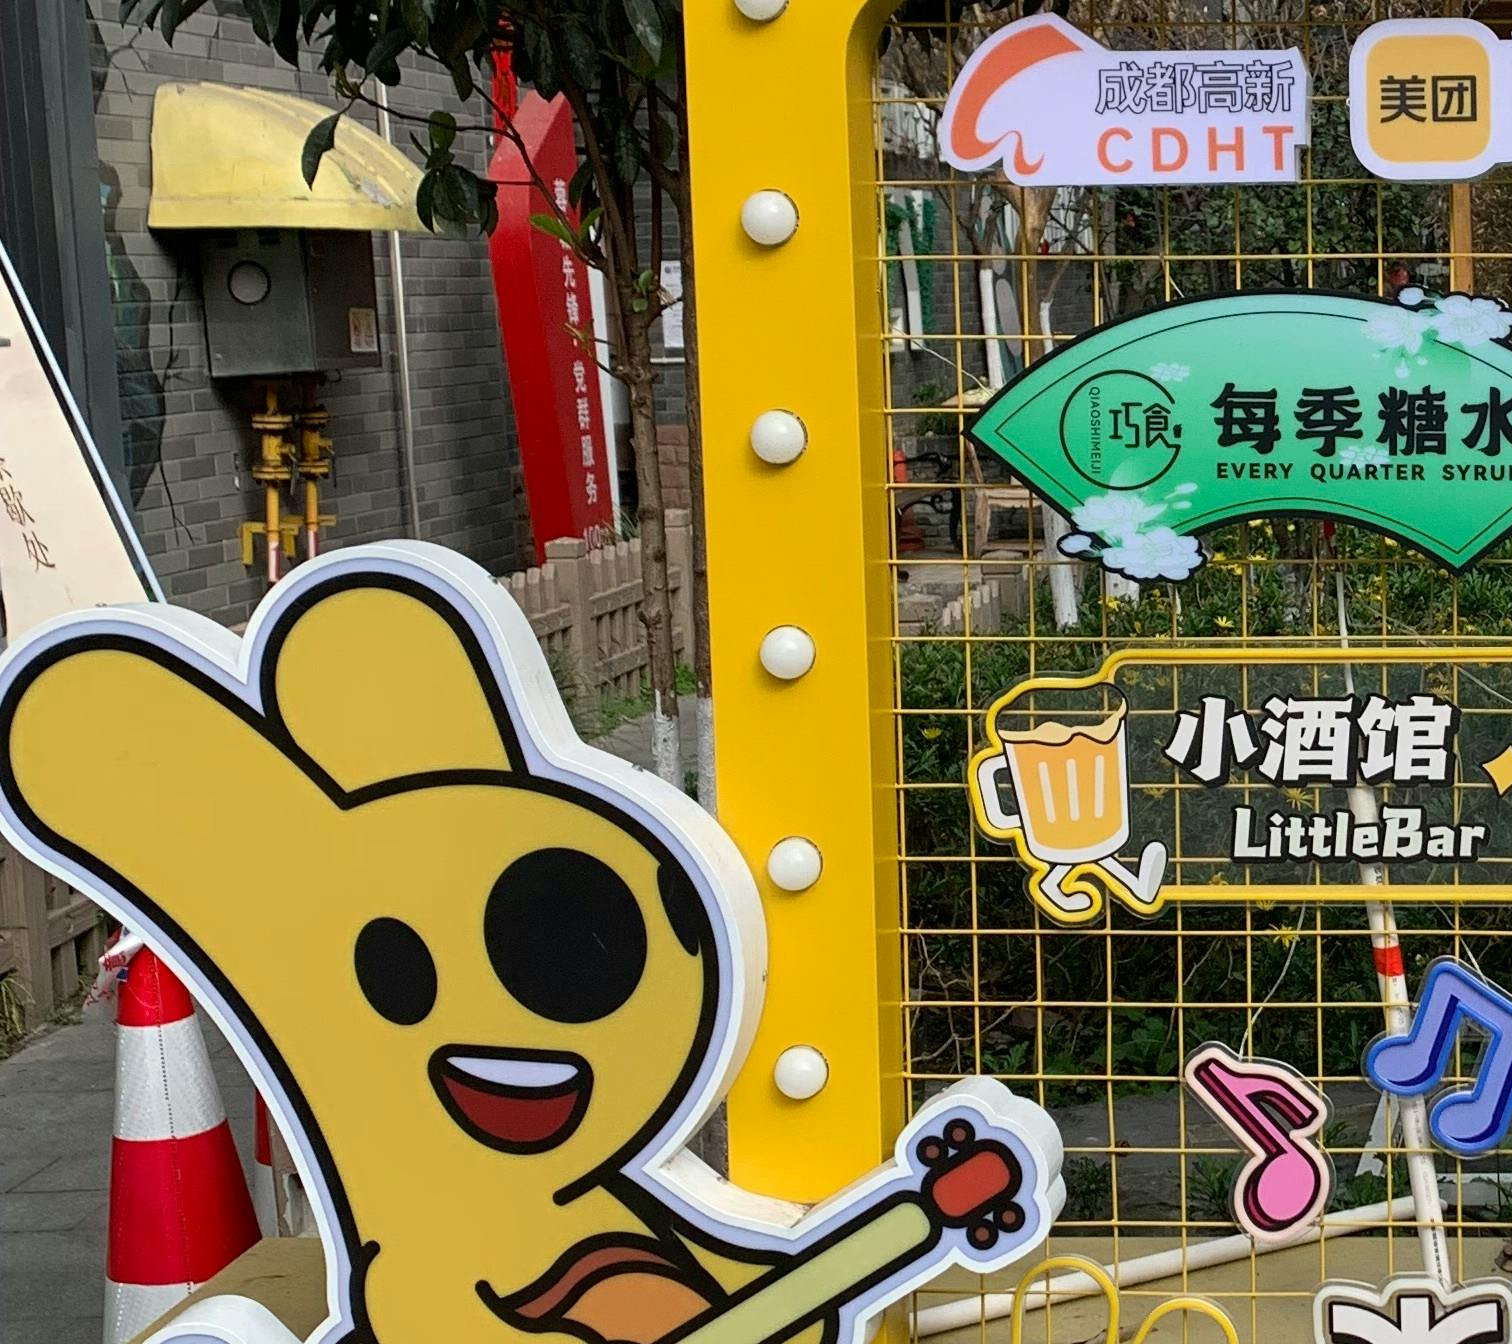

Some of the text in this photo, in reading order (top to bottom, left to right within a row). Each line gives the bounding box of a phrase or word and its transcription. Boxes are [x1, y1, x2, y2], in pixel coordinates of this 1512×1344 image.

[1094, 58, 1294, 116] 成都高新
[1379, 74, 1477, 124] 美团
[1096, 125, 1295, 174] CDHT
[1088, 385, 1102, 475] QIAOSHIMEIJI
[1215, 462, 1294, 481] EVERY
[1309, 462, 1426, 484] QUARTER
[1161, 691, 1464, 790] 小酒馆
[1229, 804, 1492, 866] LittleBar
